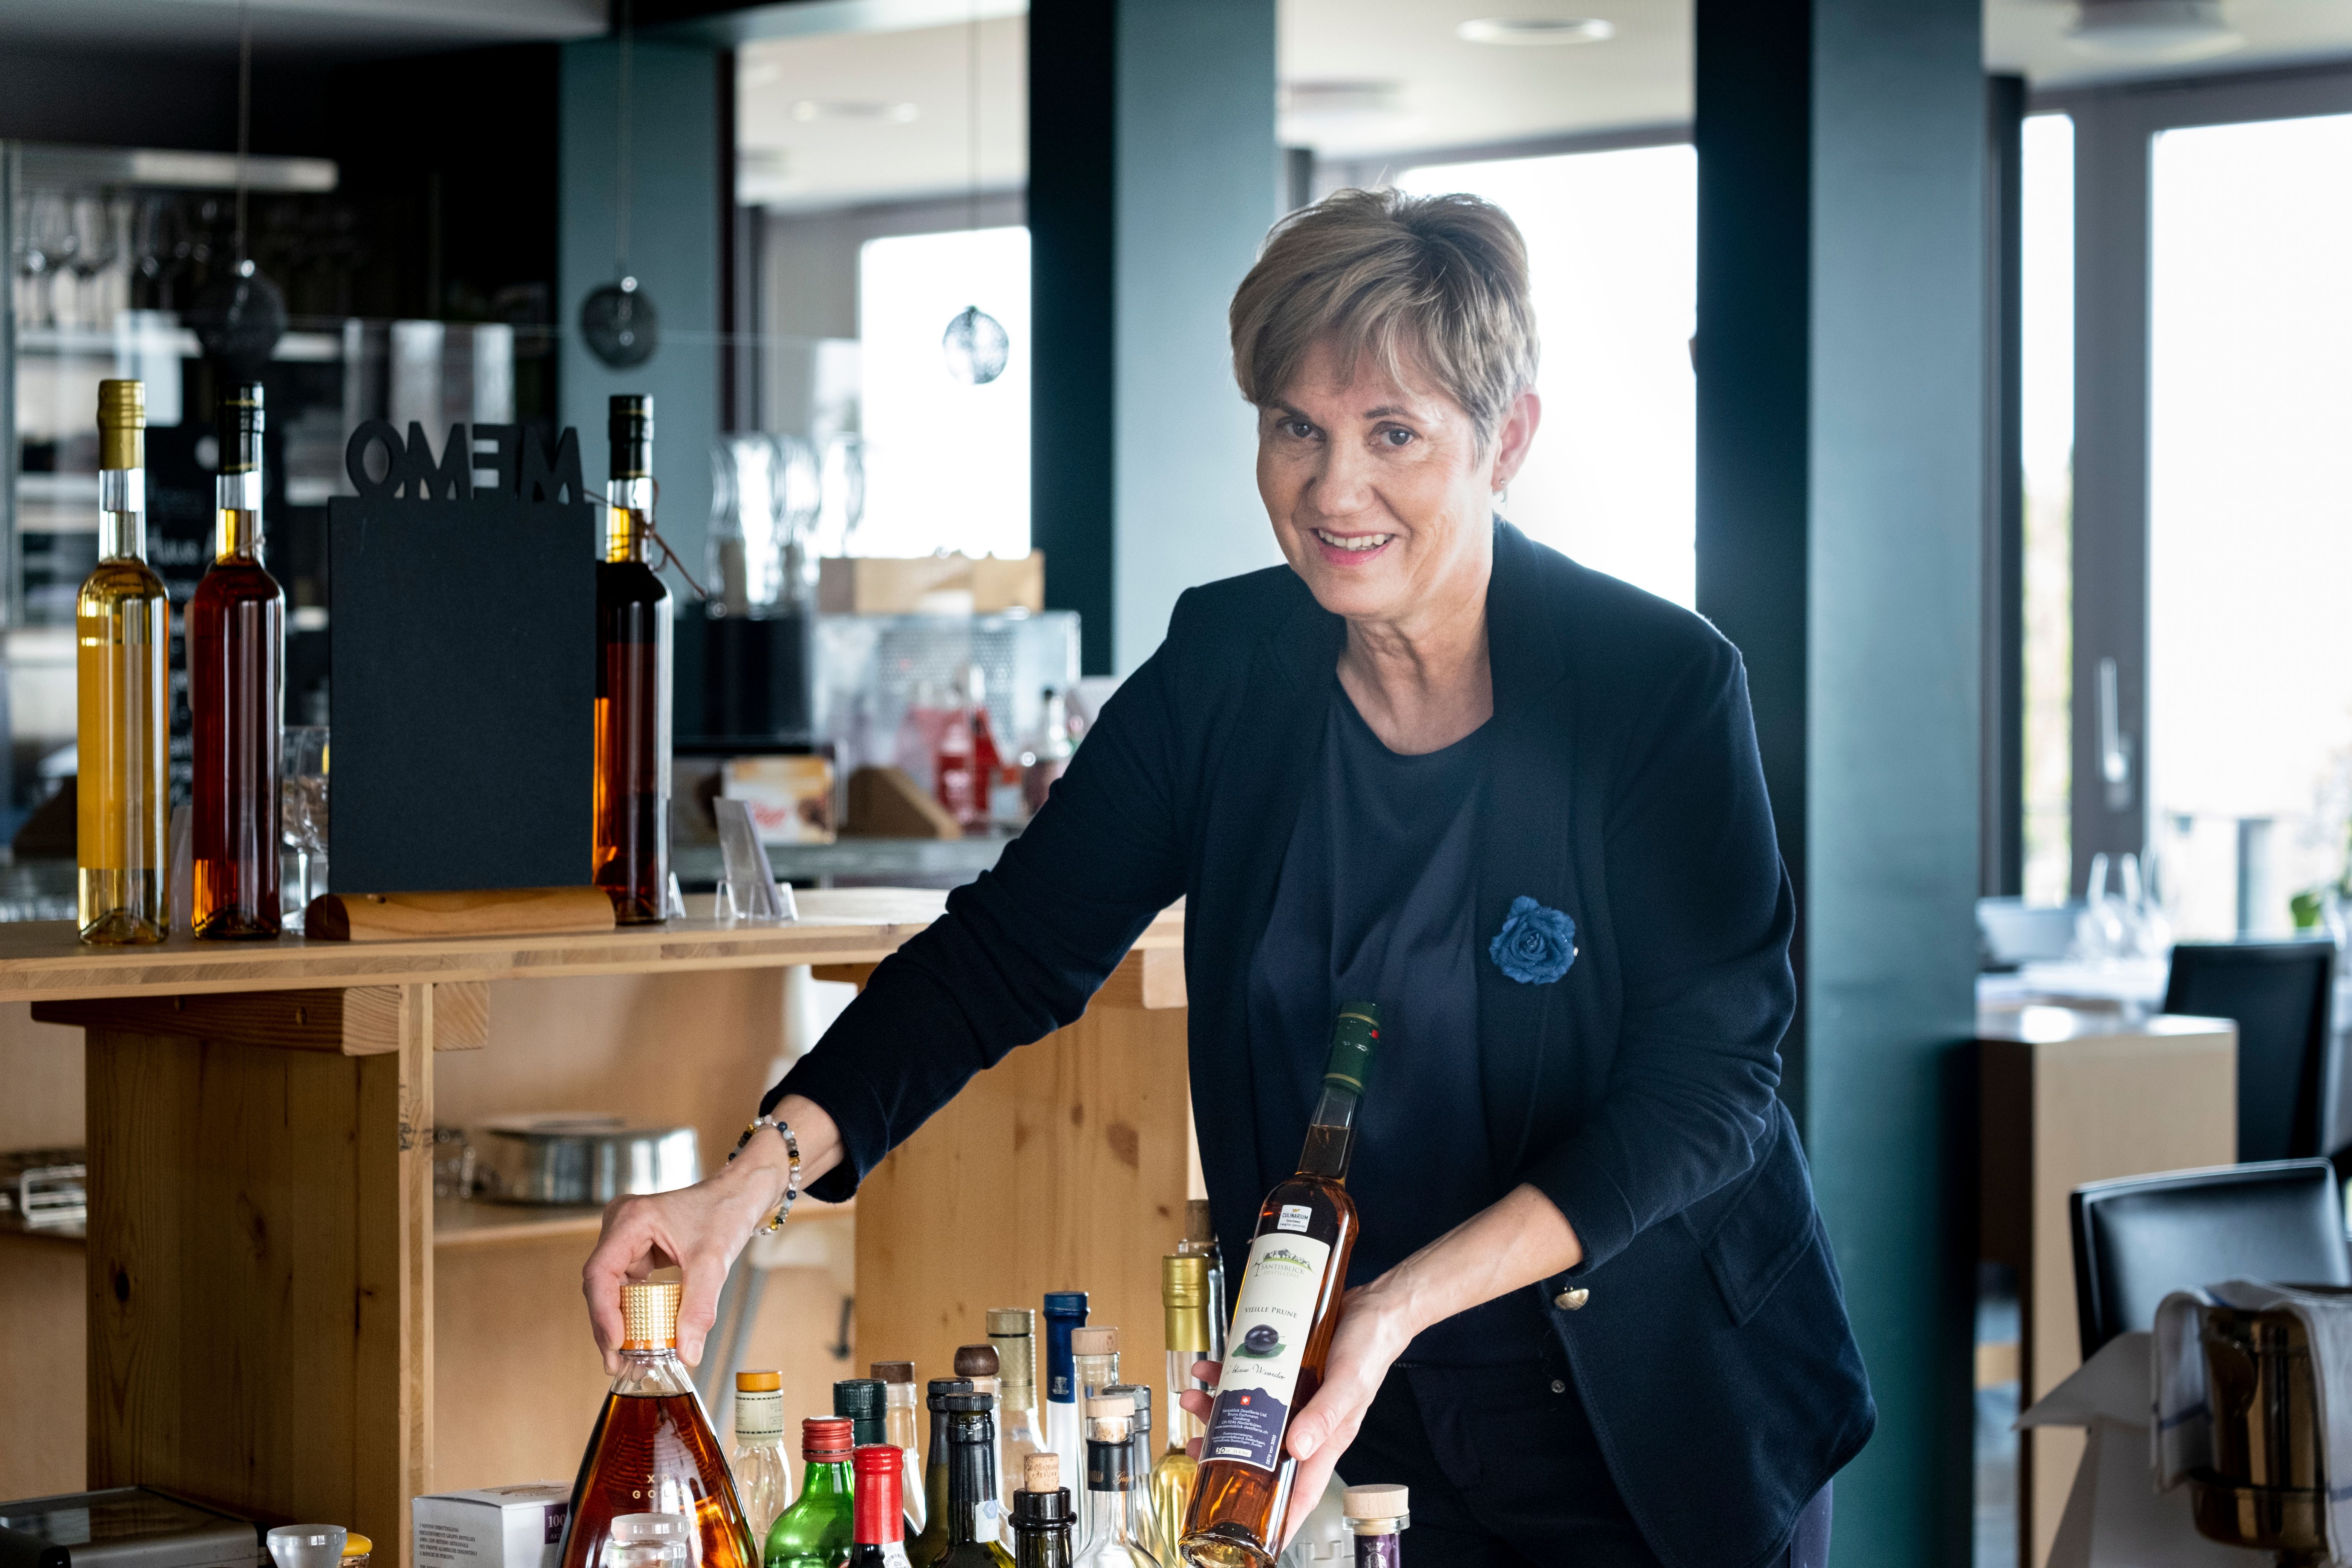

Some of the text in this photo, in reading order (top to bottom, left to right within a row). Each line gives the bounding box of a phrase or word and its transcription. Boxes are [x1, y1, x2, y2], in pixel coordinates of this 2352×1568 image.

[1263, 1270, 1300, 1279] DESTILLERIE
[1272, 1307, 1298, 1318] PRUNE
[1253, 1364, 1285, 1380] Wunder
[632, 1488, 684, 1499] GOLD
